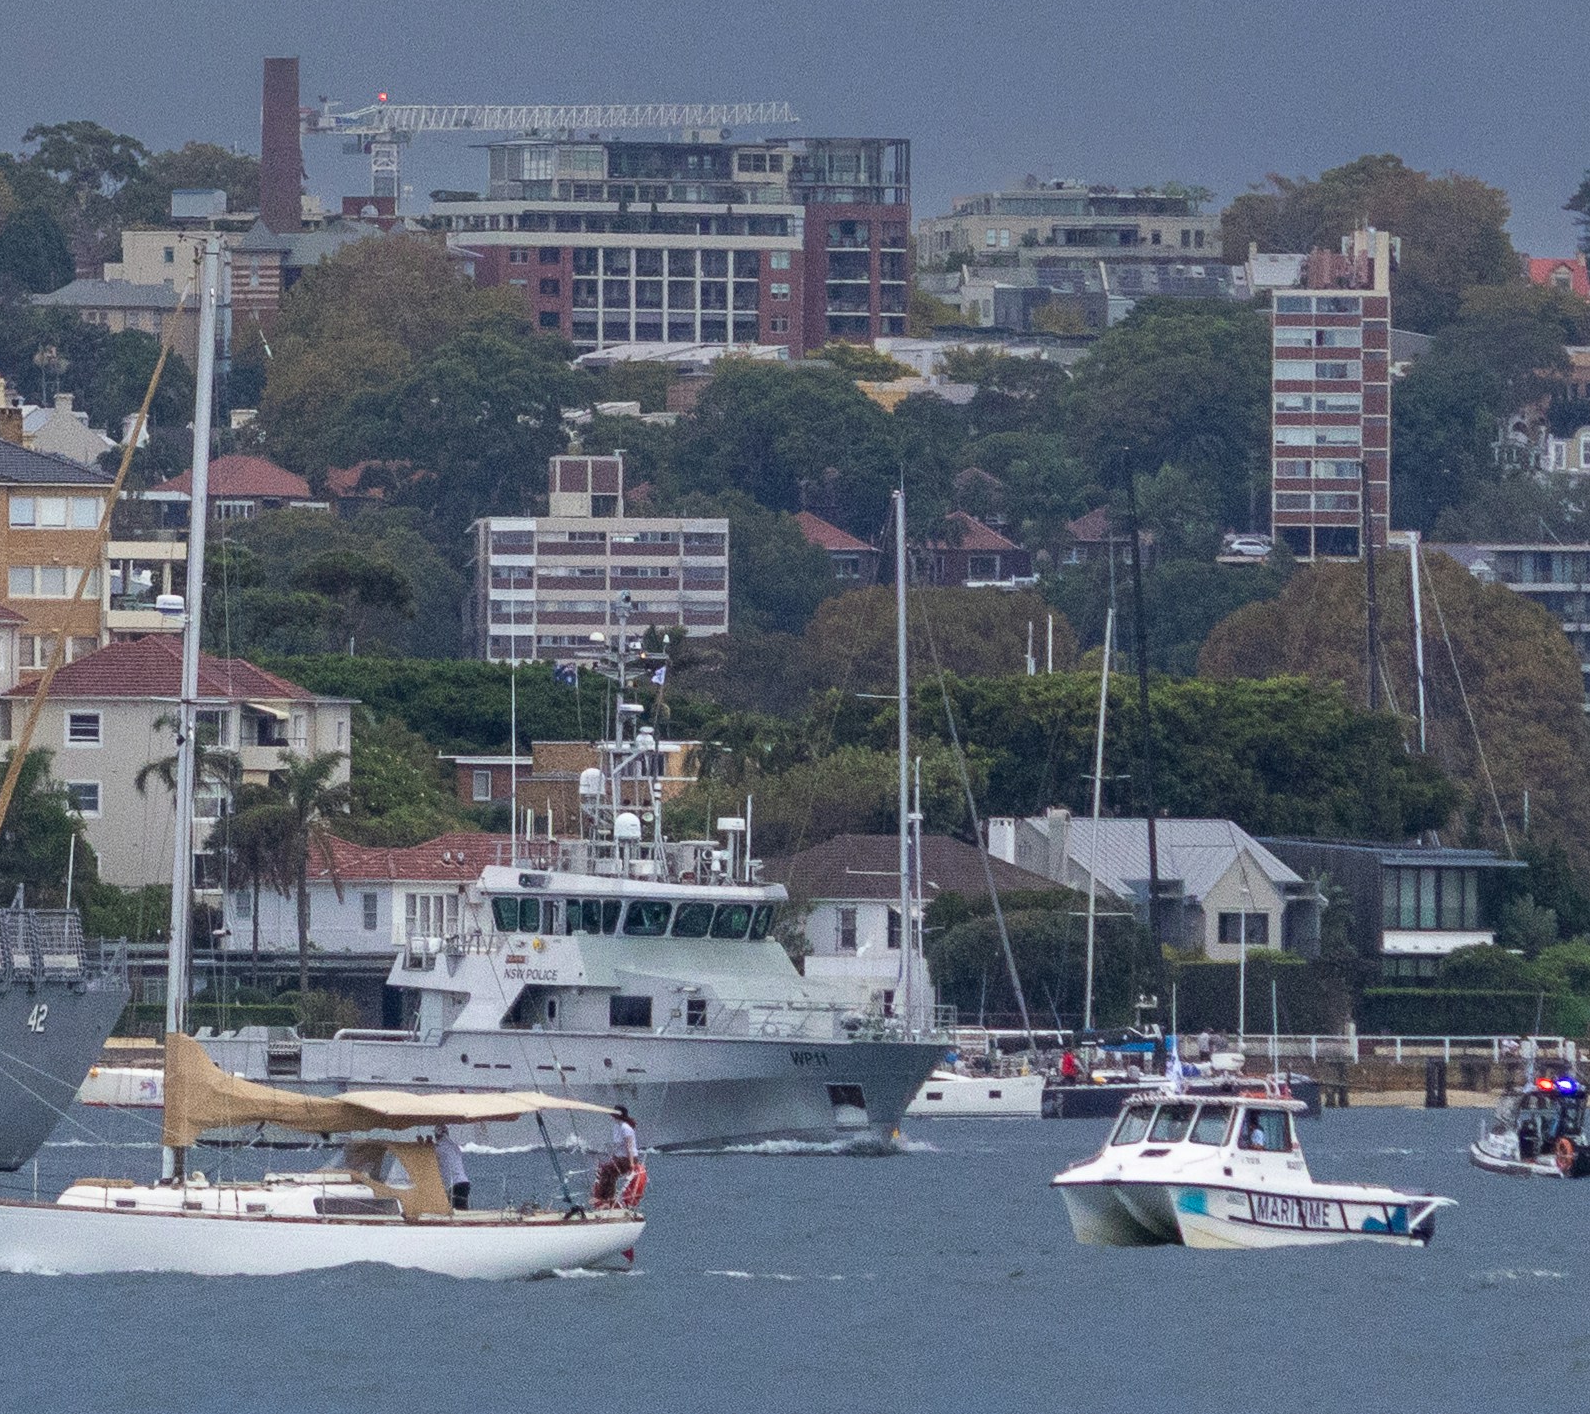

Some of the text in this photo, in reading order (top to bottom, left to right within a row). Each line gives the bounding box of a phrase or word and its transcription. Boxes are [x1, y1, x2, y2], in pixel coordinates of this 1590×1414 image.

[504, 968, 558, 981] NSW POLICE
[27, 1004, 48, 1033] 42
[1257, 1196, 1330, 1227] MARITIME
